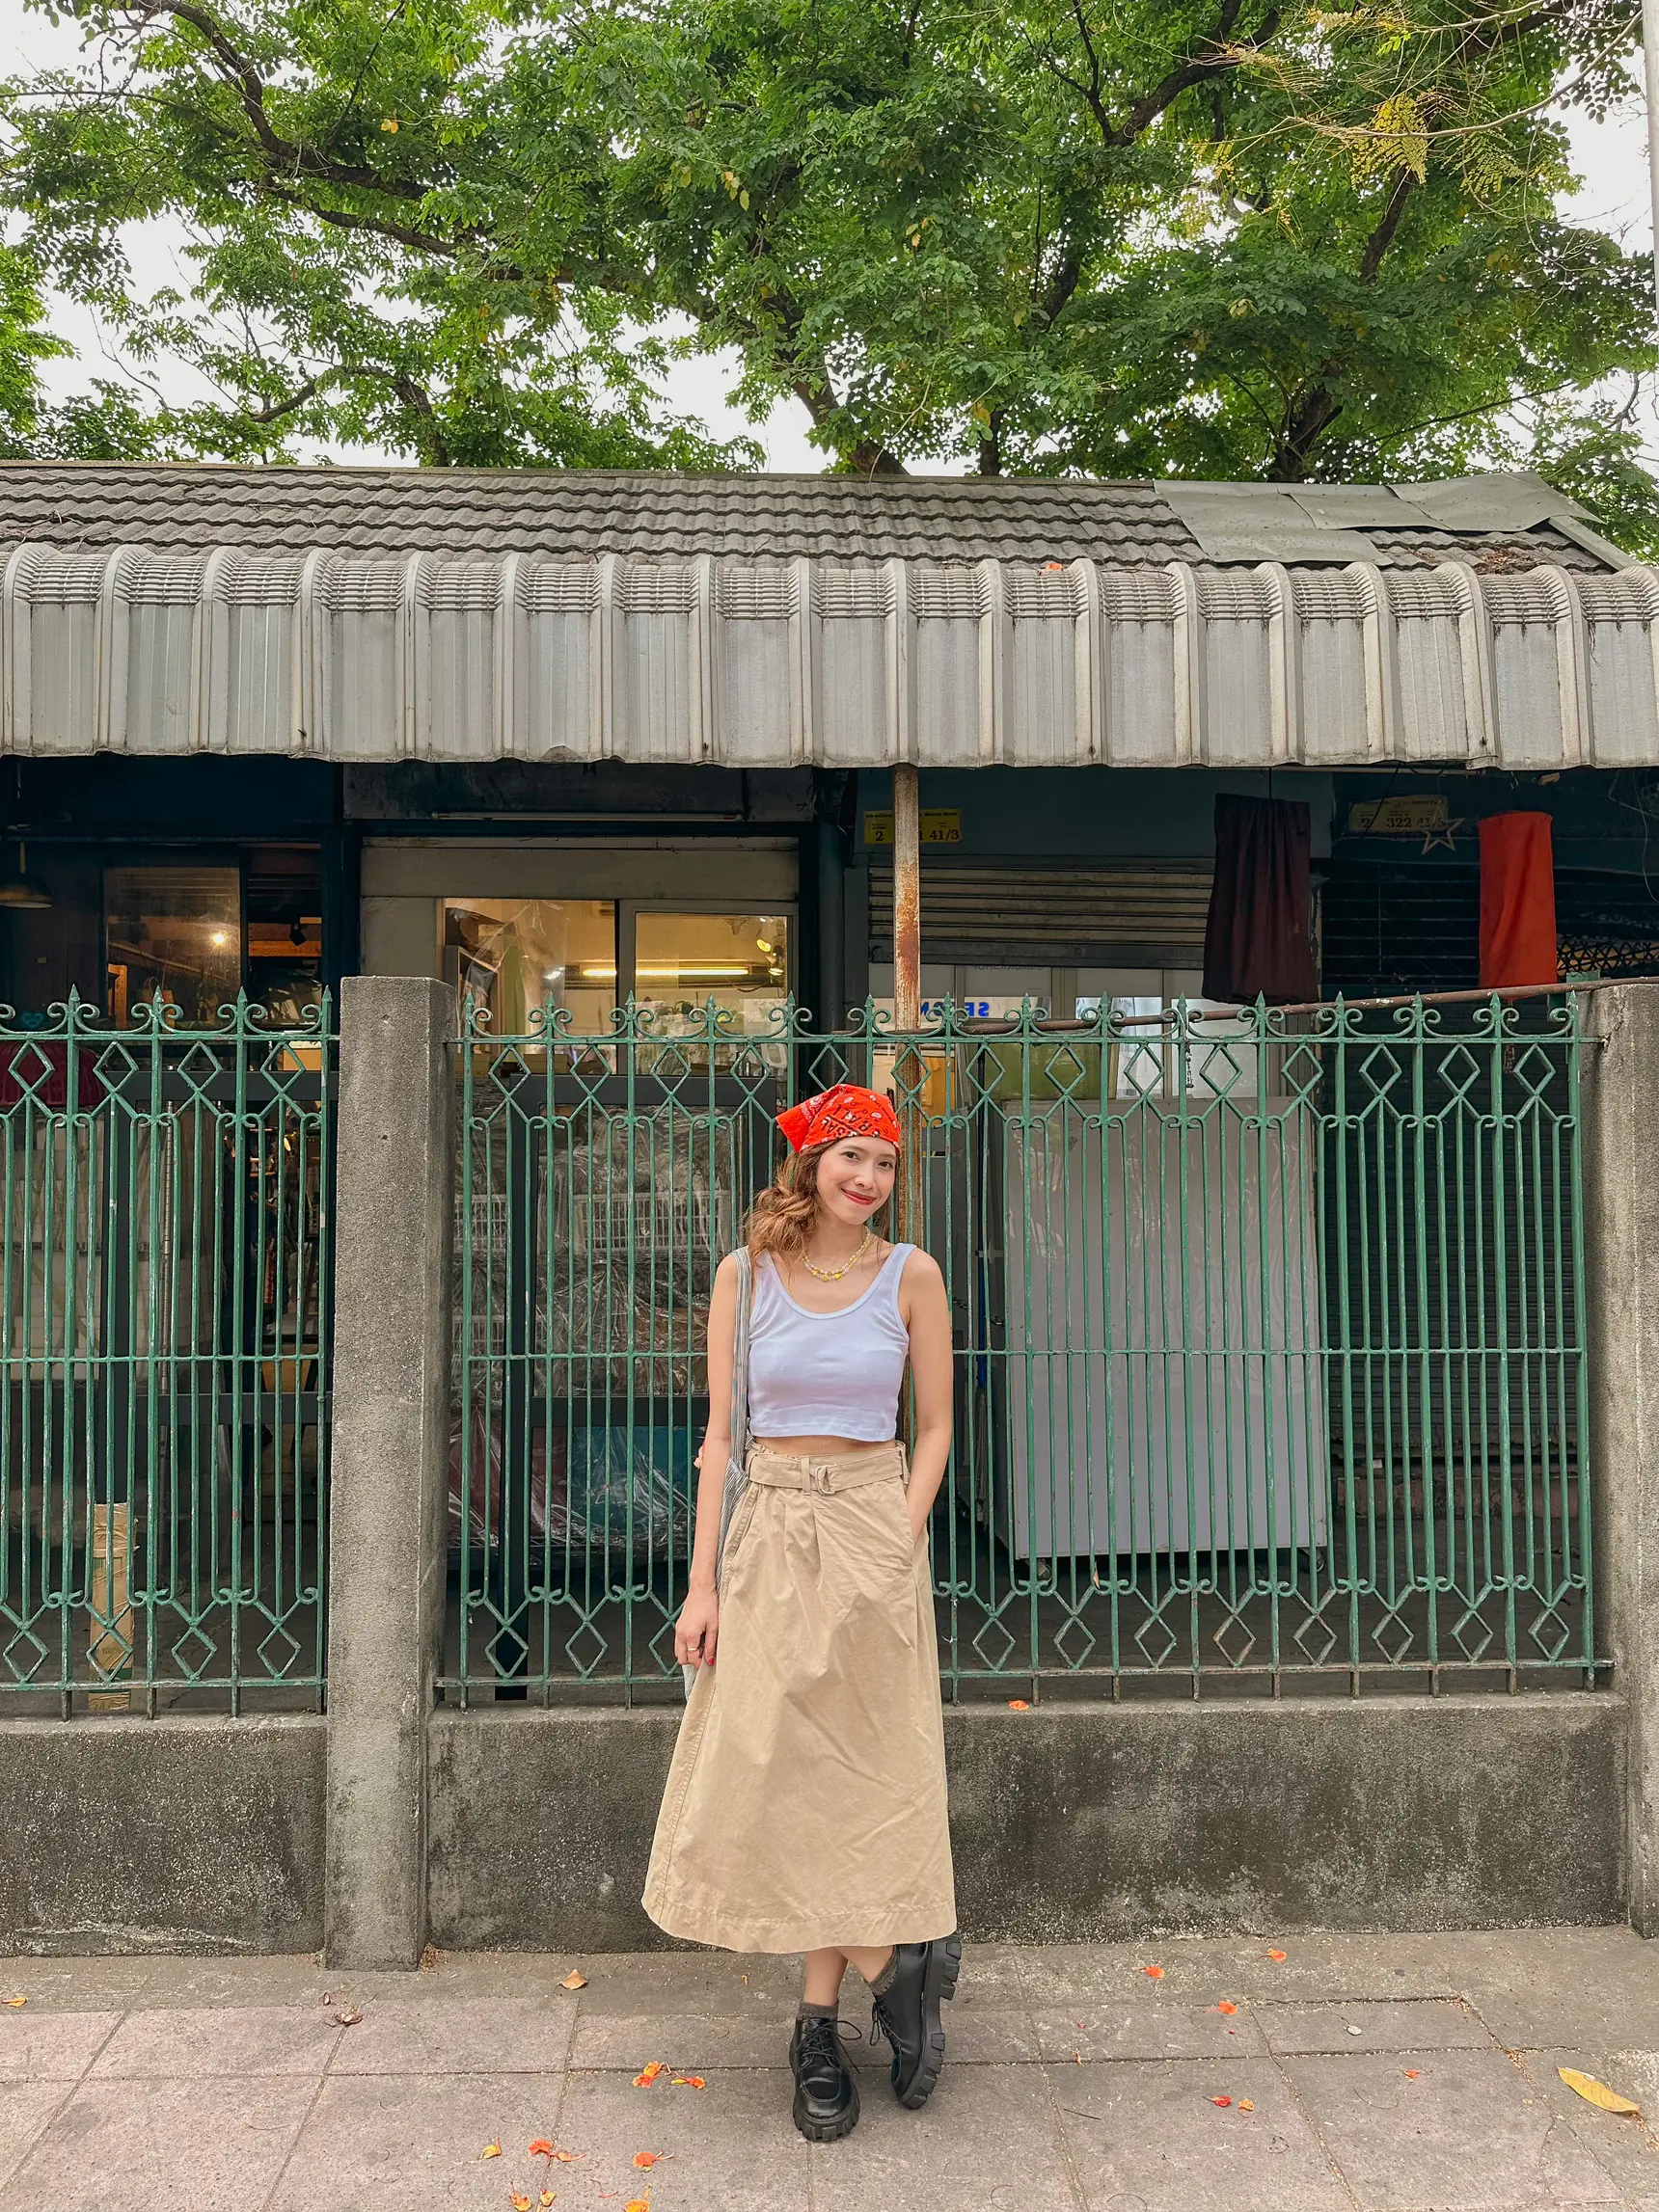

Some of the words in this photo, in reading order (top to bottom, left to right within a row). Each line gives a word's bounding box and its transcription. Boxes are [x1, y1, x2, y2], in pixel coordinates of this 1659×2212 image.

[1387, 818, 1412, 827] 322
[876, 831, 884, 841] 2
[930, 829, 959, 841] 41/3
